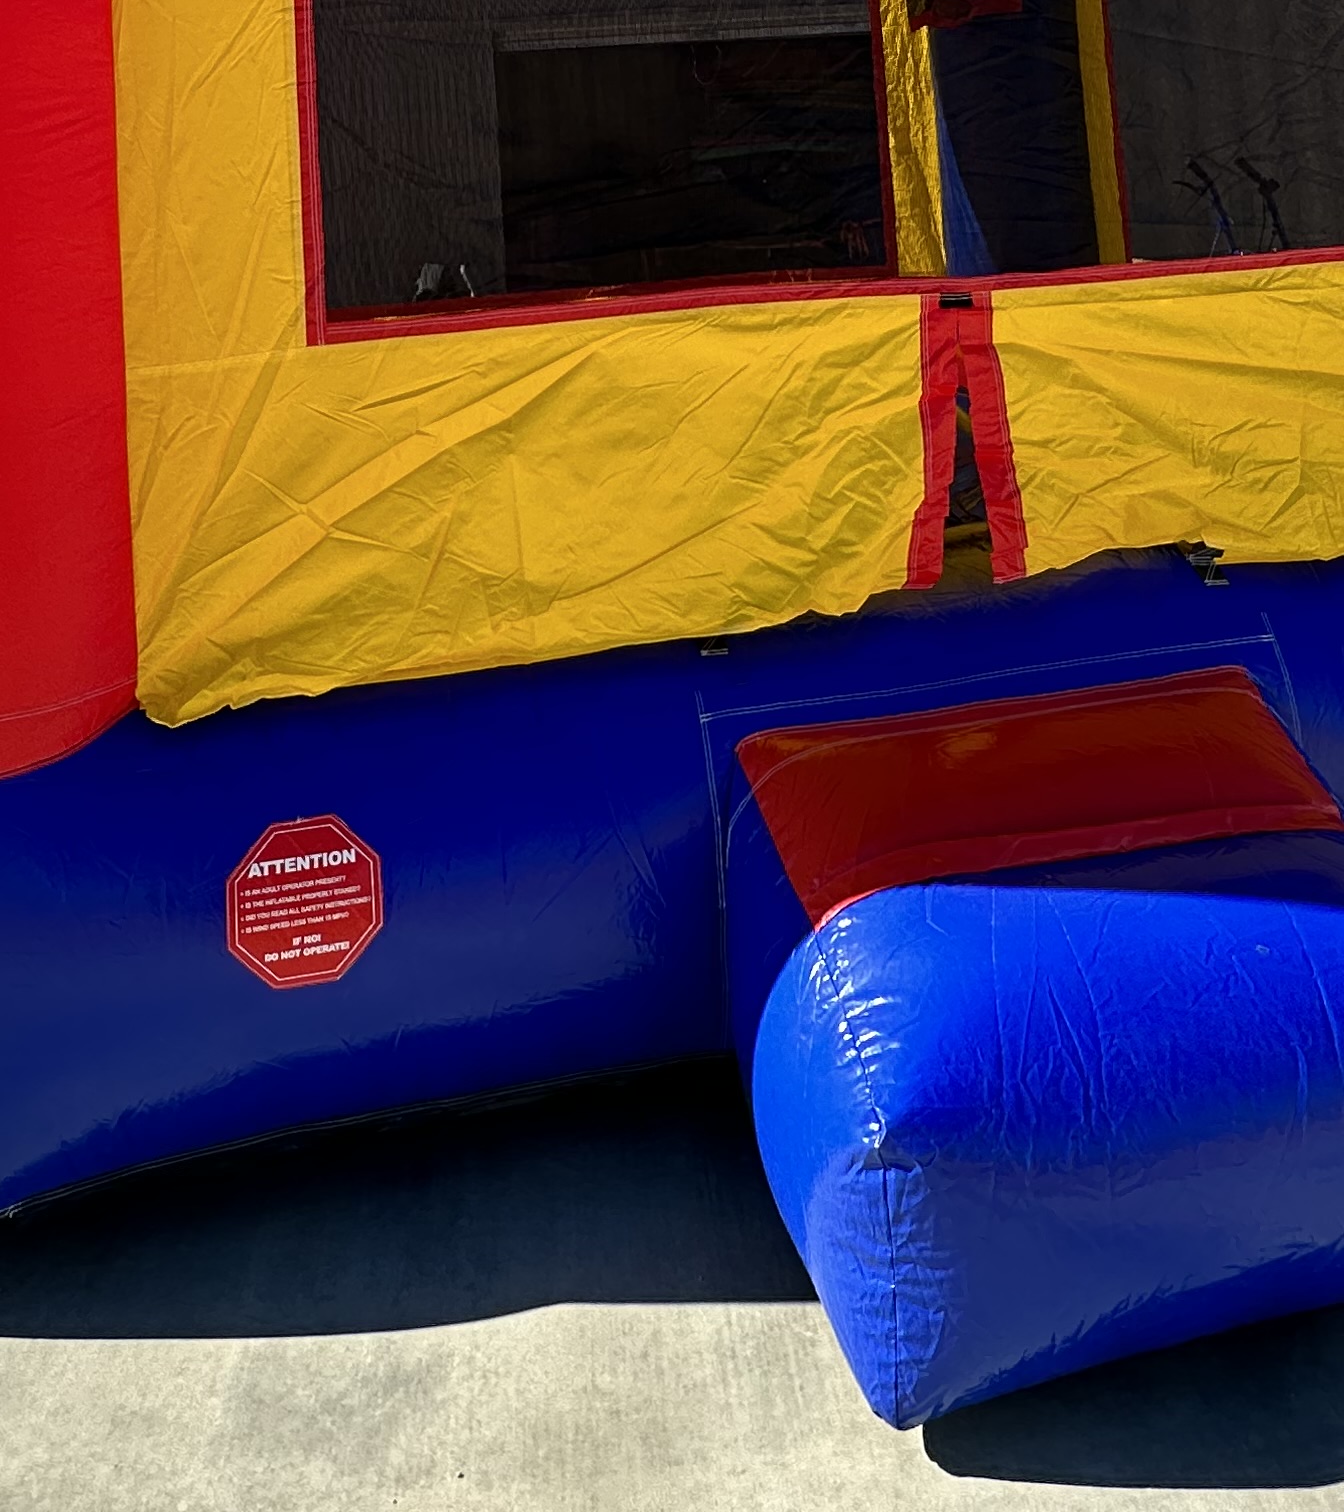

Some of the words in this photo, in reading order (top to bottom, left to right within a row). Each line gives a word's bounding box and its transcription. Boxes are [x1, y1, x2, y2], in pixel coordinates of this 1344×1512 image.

[247, 848, 356, 879] ATTENTION
[264, 952, 278, 962] DO
[280, 948, 302, 960] NOT
